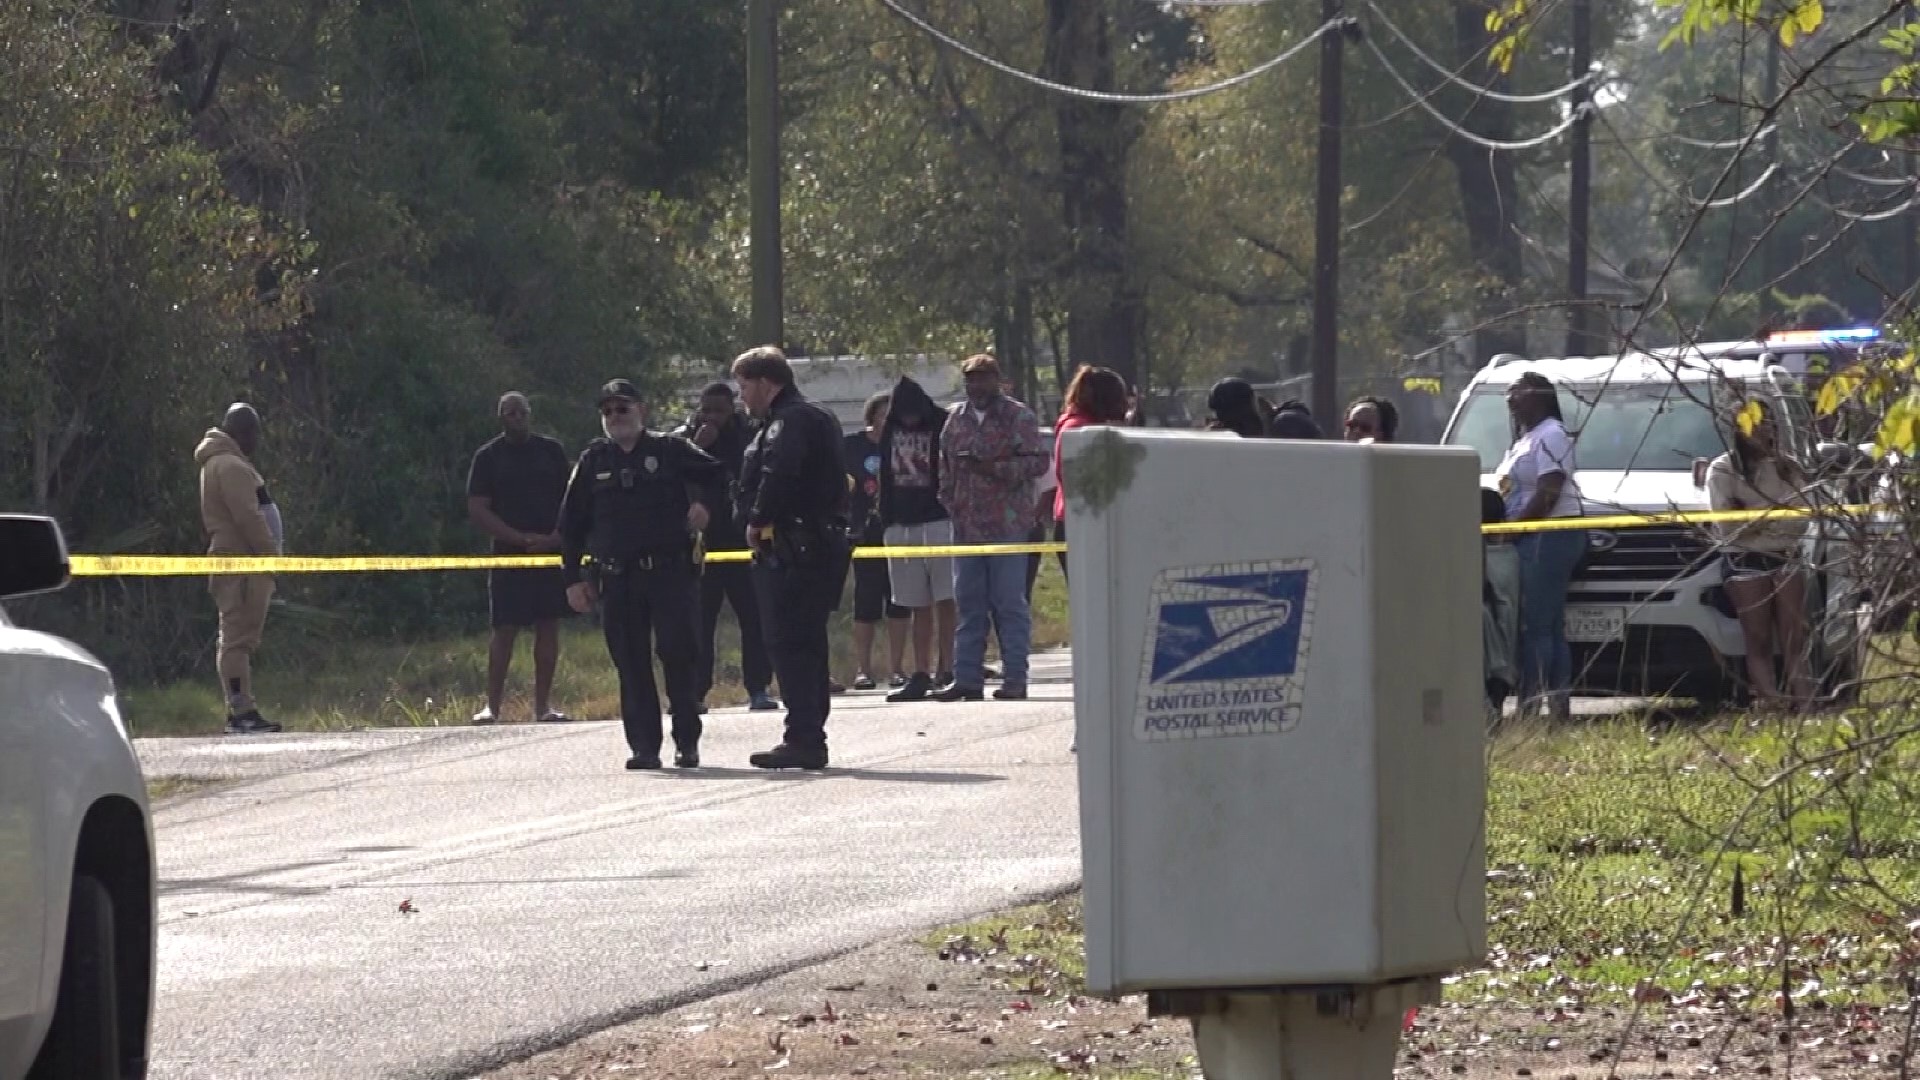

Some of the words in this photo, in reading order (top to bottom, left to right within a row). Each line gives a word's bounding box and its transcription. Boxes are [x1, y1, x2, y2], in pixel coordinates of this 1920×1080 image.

[1147, 694, 1216, 710] UNITED
[1218, 688, 1284, 705] STATES
[1145, 713, 1211, 732] POSTAL
[1217, 707, 1290, 726] SERVICE
